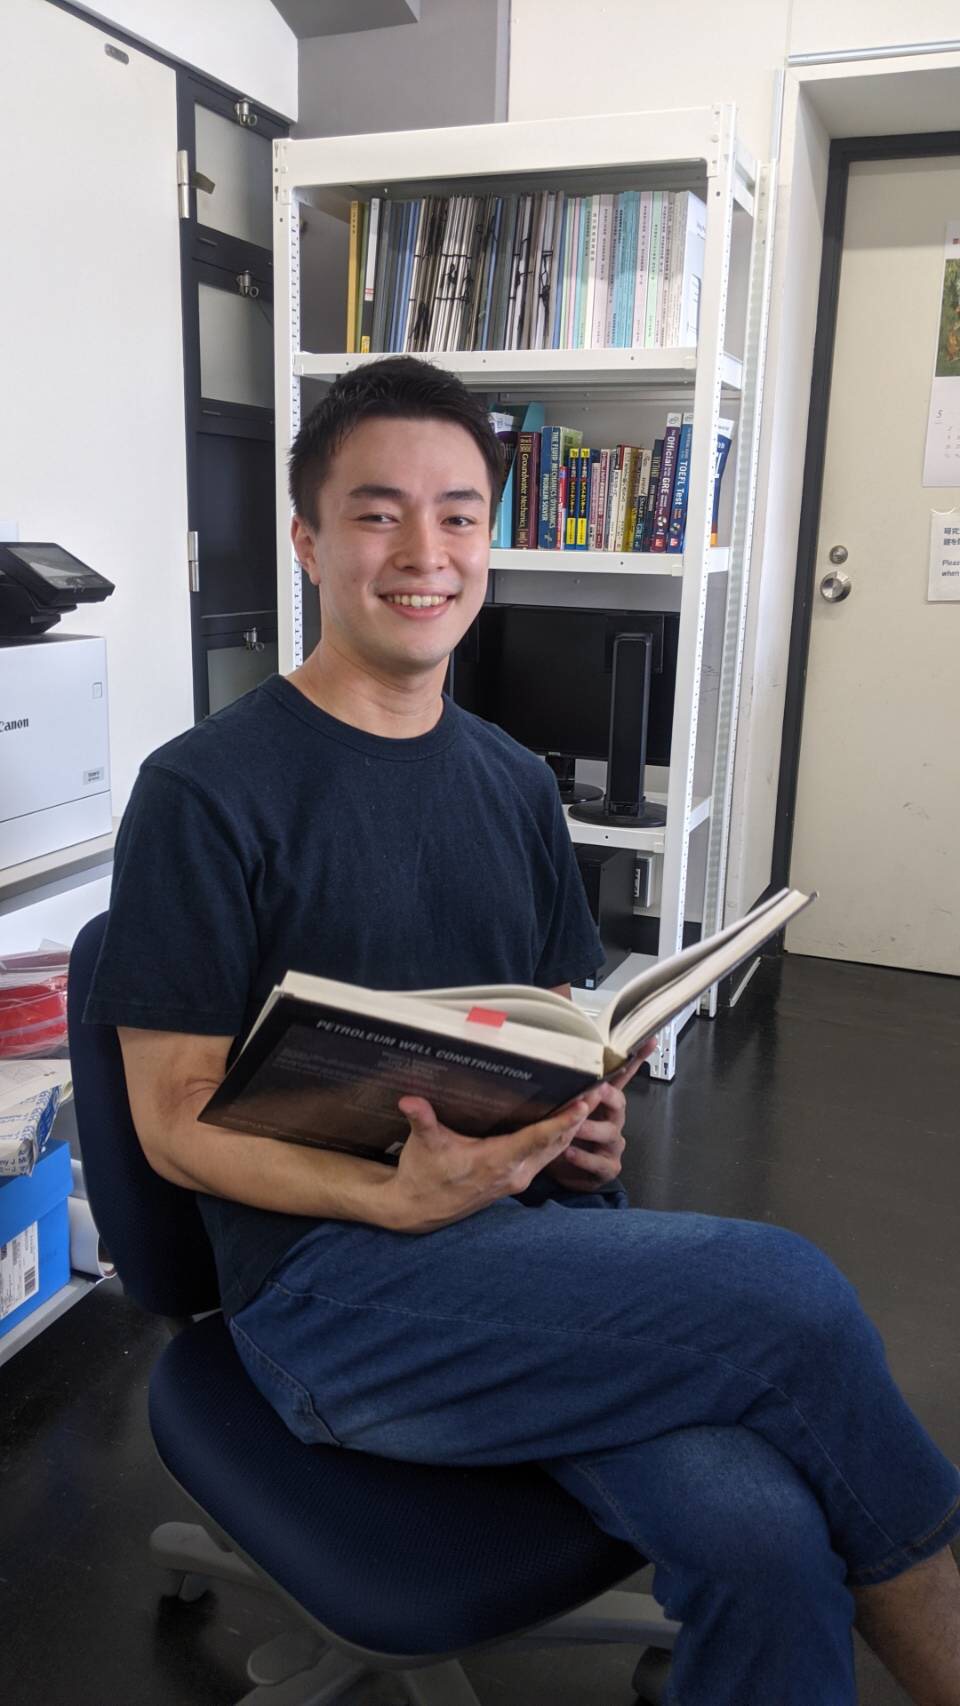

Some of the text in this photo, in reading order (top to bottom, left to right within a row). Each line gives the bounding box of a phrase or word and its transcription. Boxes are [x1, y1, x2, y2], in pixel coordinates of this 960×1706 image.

[663, 435, 677, 467] Official
[520, 453, 530, 494] Groundwater
[660, 477, 671, 494] GRE
[675, 460, 688, 486] TOEFL
[518, 495, 528, 528] Mechanics
[541, 473, 550, 521] PROBLEM SOLVER
[674, 488, 686, 505] Test
[315, 1019, 396, 1046] PETROLEUM
[399, 1039, 433, 1057] WELL
[435, 1050, 533, 1081] CONSTRUCTION
